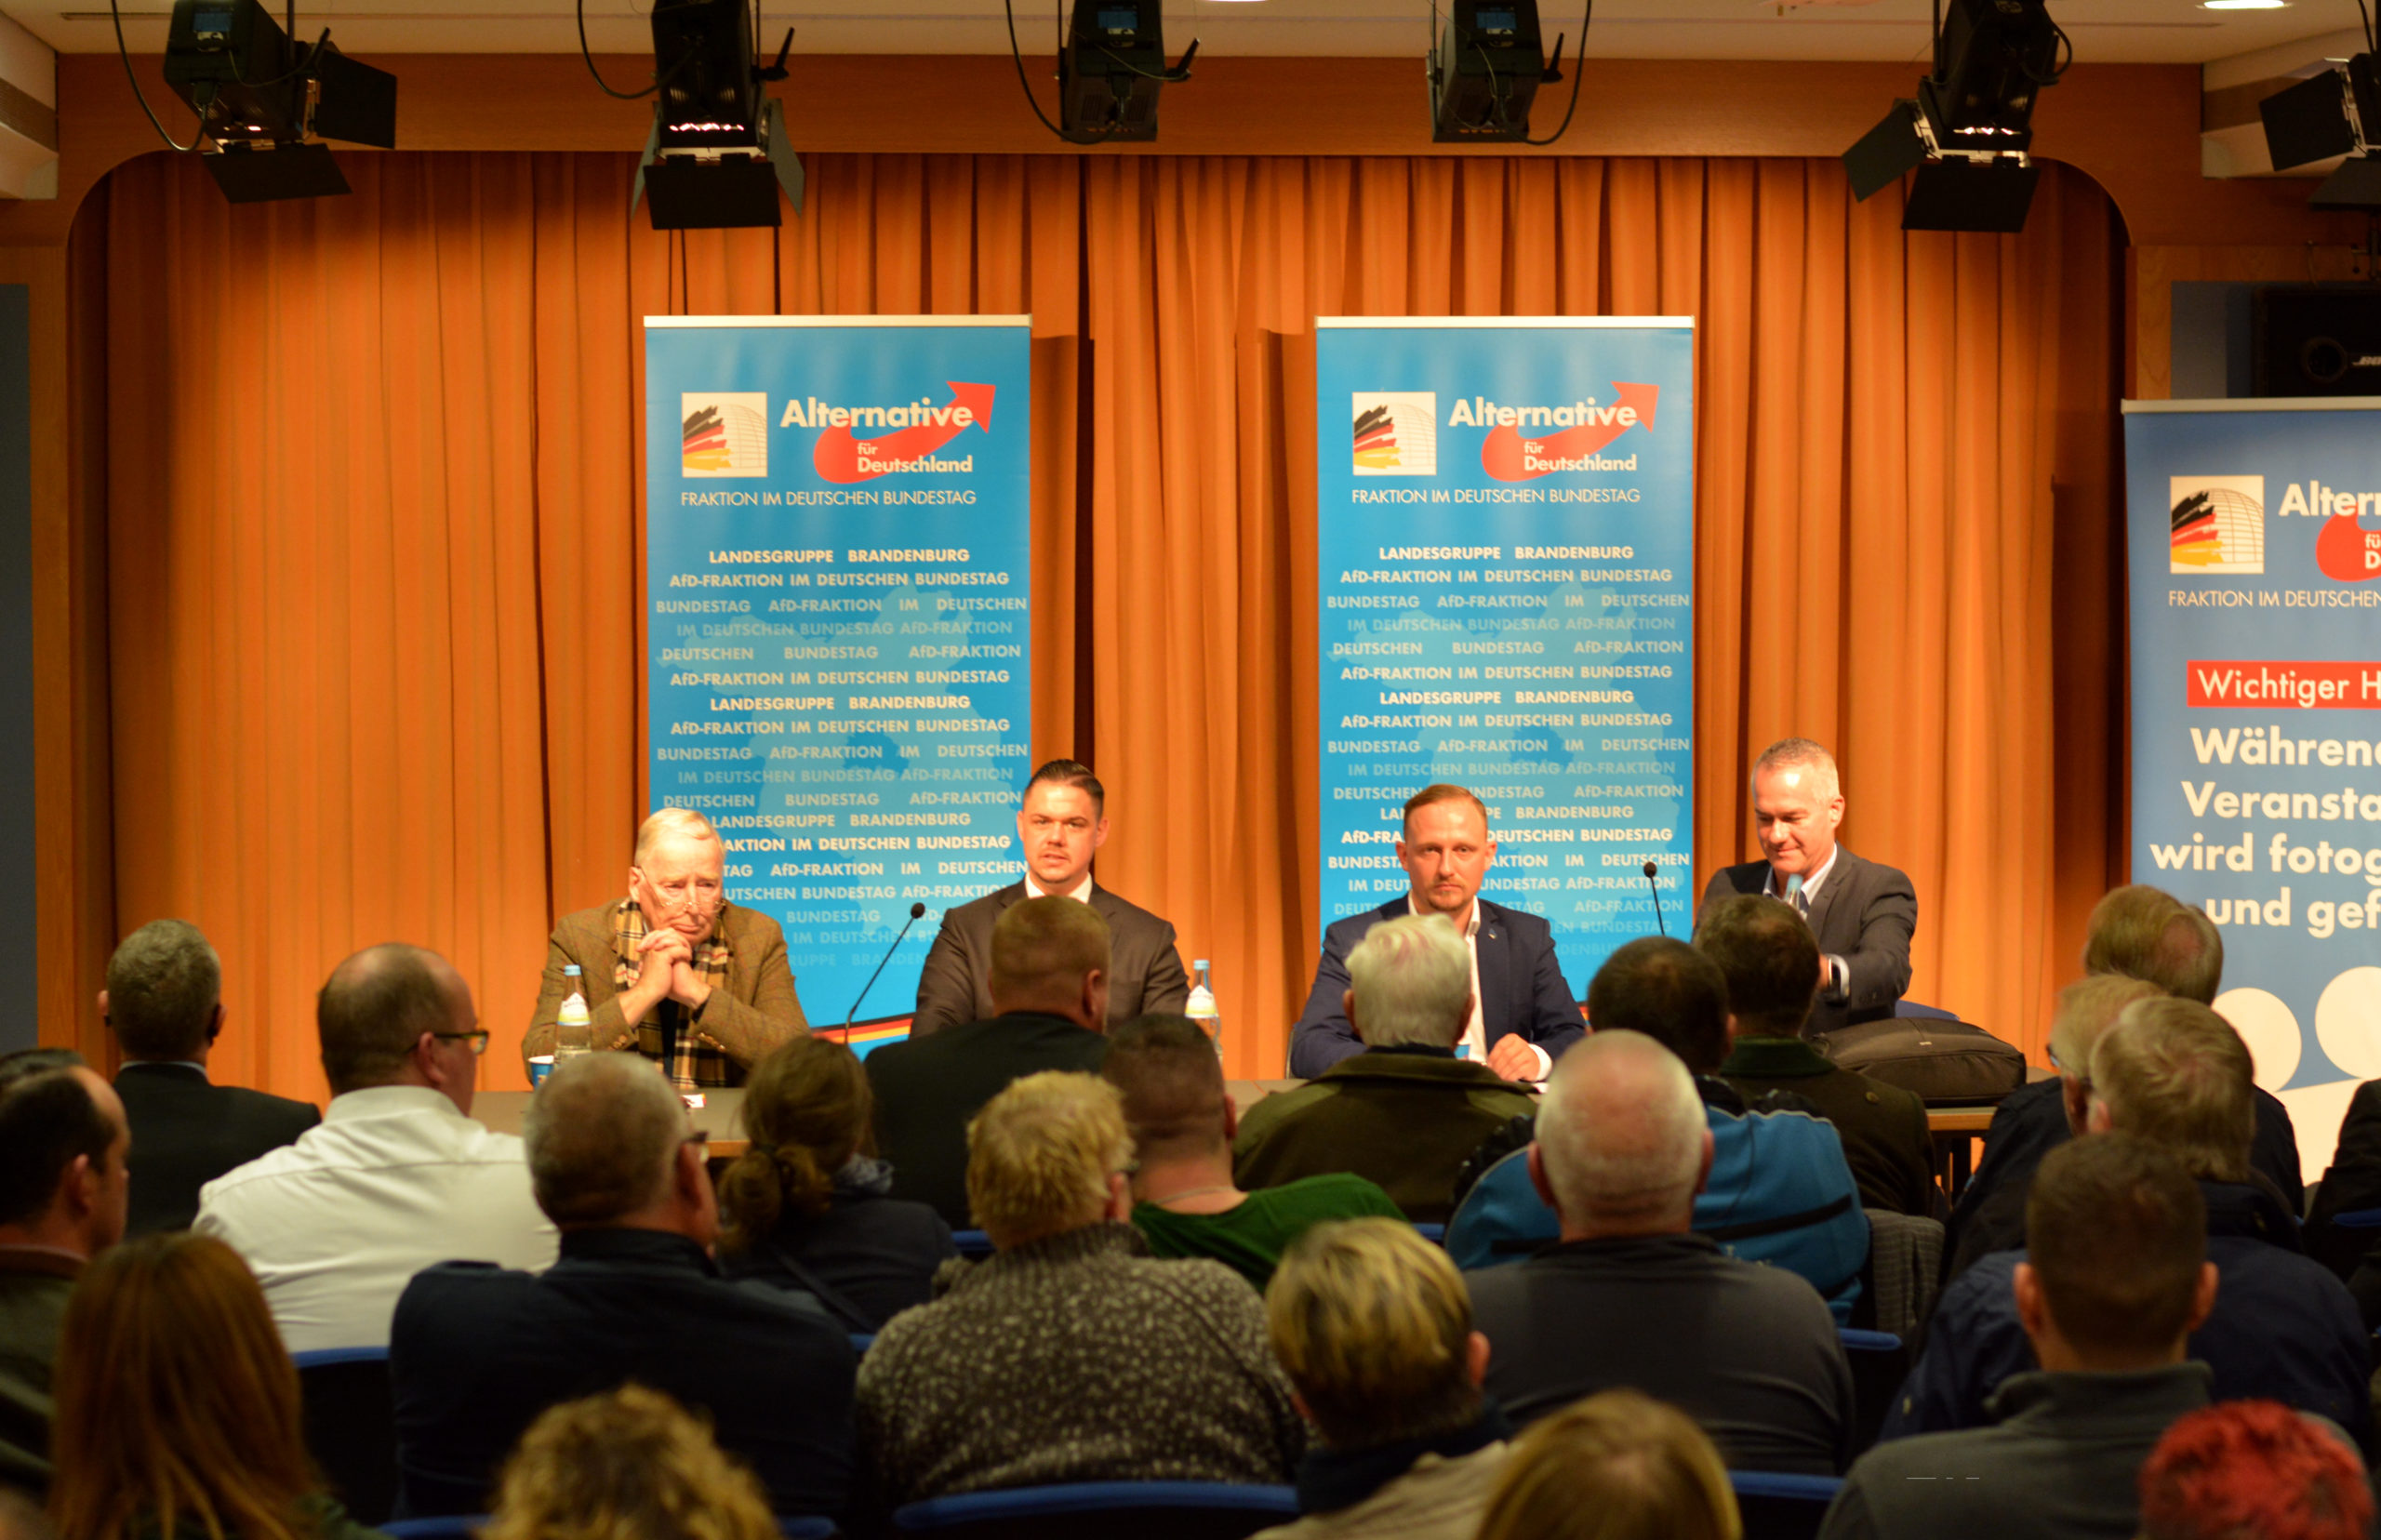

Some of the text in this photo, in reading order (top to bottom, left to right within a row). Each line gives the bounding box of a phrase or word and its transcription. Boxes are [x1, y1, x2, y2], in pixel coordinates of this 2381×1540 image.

[780, 397, 973, 428] Alternative
[1449, 397, 1638, 427] Alternative
[858, 443, 877, 456] für
[1524, 442, 1544, 454] für
[858, 456, 973, 472] Deutschland
[1524, 455, 1637, 471] Deutschland
[681, 491, 977, 506] FRAKTION IM DEUTSCHEN BUNDESTAG
[1352, 488, 1641, 504] FRAKTION IM DEUTSCHEN BUNDESTAG
[2365, 534, 2381, 549] fü
[710, 550, 969, 563] LANDESGRUPPE BRANDENBURG
[1379, 547, 1633, 560] LANDESGRUPPE BRANDENBURG
[670, 572, 1009, 588] AfD-FRAKTION IM DEUTSCHEN BUNDESTAG
[1340, 569, 1672, 583] AfD-FRAKTION IM DEUTSCHEN BUNDESTAG
[657, 598, 1027, 613] BUNDESTAG AfD-FRAKTION IM DEUTSCHEN
[1327, 594, 1689, 608] BUNDESTAG AfD-FRAKTION IM DEUTSCHEN
[2169, 591, 2253, 607] FRAKTION
[2259, 591, 2280, 606] IM
[677, 621, 1012, 636] IM DEUTSCHEN BUNDESTAG AfD-FRAKTION
[1348, 617, 1675, 631] IM DEUTSCHEN BUNDESTAG AfD-FRAKTION
[662, 645, 1021, 660] DEUTSCHEN BUNDESTAG AfD-FRAKTION
[1333, 641, 1683, 655] DEUTSCHEN BUNDESTAG AfD-FRAKTION
[671, 670, 1010, 685] AfD-FRAKTION IM DEUTSCHEN BUNDESTAG
[1341, 666, 1672, 680] AfD-FRAKTION IM DEUTSCHEN BUNDESTAG
[2197, 668, 2348, 708] Wichtiger
[711, 697, 970, 710] LANDESGRUPPE BRANDENBURG
[1380, 691, 1634, 704] LANDESGRUPPE BRANDENBURG
[671, 719, 1010, 735] AfD-FRAKTION IM DEUTSCHEN BUNDESTAG
[1341, 713, 1672, 728] AfD-FRAKTION IM DEUTSCHEN BUNDESTAG
[658, 745, 1028, 761] BUNDESTAG AfD-FRAKTION IM DEUTSCHEN
[1328, 738, 1690, 753] BUNDESTAG AfD-FRAKTION IM DEUTSCHEN
[678, 767, 1014, 784] IM DEUTSCHEN BUNDESTAG AfD-FRAKTION
[1348, 761, 1675, 777] IM DEUTSCHEN BUNDESTAG AfD-FRAKTION
[663, 791, 1021, 807] DEUTSCHEN BUNDESTAG AfD-FRAKTION
[1474, 786, 1545, 799] NDESTAG
[1575, 784, 1684, 798] AfD-FRAKTION
[2181, 781, 2381, 820] Veransta
[1516, 806, 1634, 819] BRANDENBURG
[712, 813, 971, 829] LANDESGRUPPE BRANDENBURG
[1341, 830, 1403, 843] AfD-FRA
[1581, 829, 1672, 841] BUNDESTAG
[725, 836, 1011, 852] AKTION IM DEUTSCHEN BUNDESTAG
[1328, 853, 1690, 869] BUNDEST AKTION IM DEUTSCHEN
[2149, 832, 2381, 885] wird fotog
[770, 861, 1029, 877] AfD-FRAKTION IM DEUTSCHEN
[725, 884, 1007, 900] UTSCHEN BUNDESTAG AfD-FRAKTIO
[1349, 879, 1368, 892] IM
[1483, 878, 1560, 891] UNDESTAG
[1566, 877, 1675, 890] AfD-FRAKTION
[787, 909, 880, 923] BUNDESTAG
[2205, 887, 2381, 938] und gef
[793, 933, 813, 944] IM
